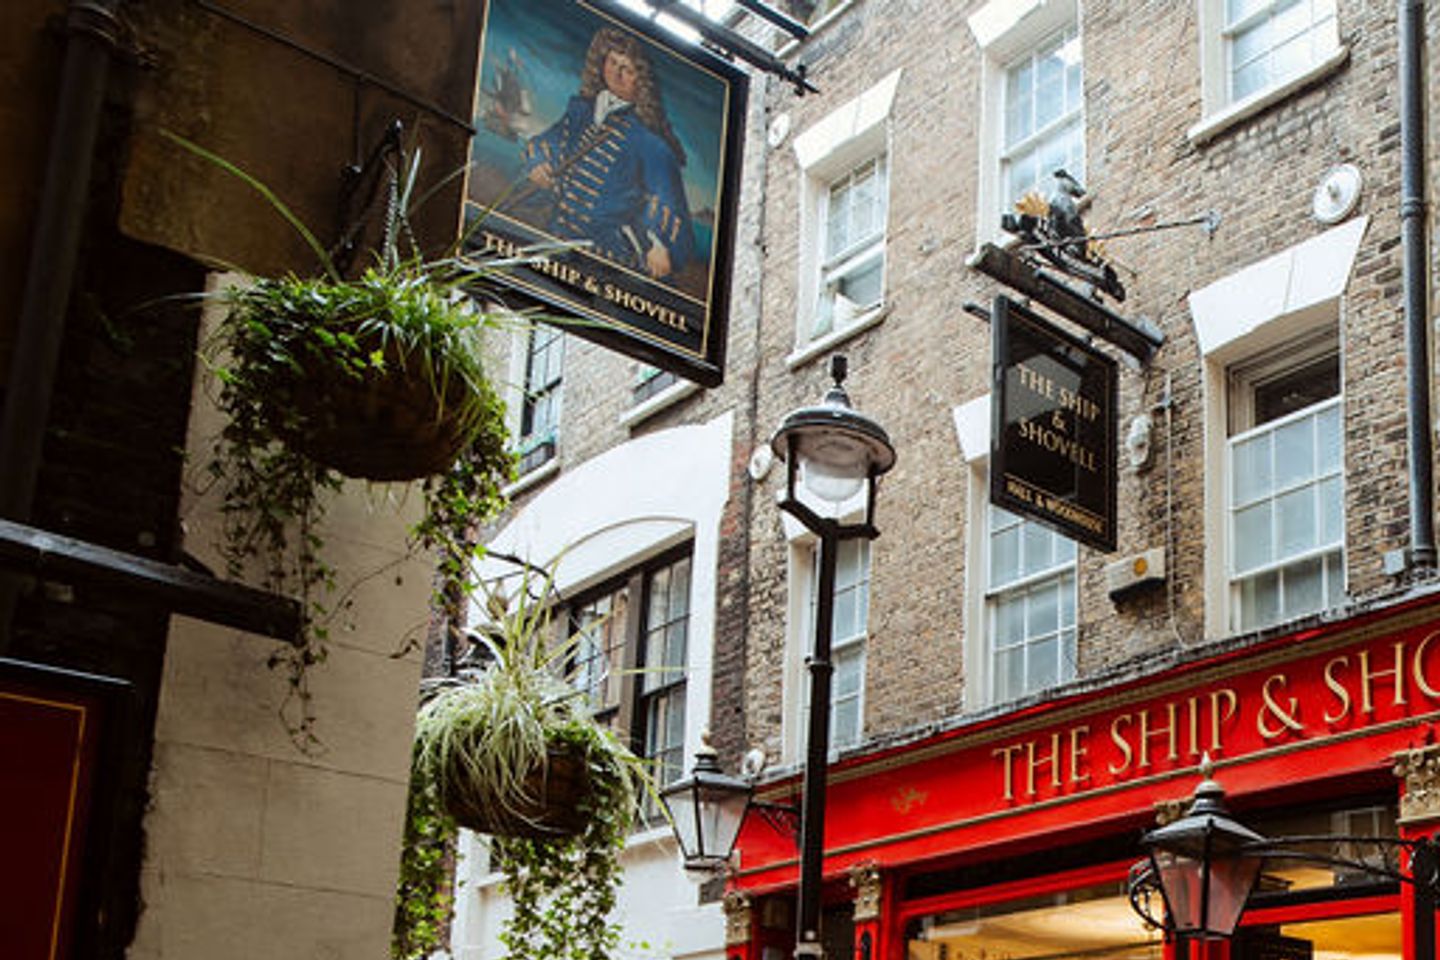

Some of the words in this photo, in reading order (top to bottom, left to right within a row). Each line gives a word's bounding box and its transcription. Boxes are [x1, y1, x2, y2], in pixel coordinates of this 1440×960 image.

[584, 275, 599, 294] &
[604, 284, 688, 332] SHOVELL
[1017, 363, 1055, 400] THE
[1060, 387, 1100, 421] SHIP
[1019, 416, 1096, 472] SHOVELL
[1052, 410, 1067, 432] &
[992, 725, 1092, 801] THE
[1107, 687, 1239, 776] SHIP
[1256, 673, 1305, 741] &
